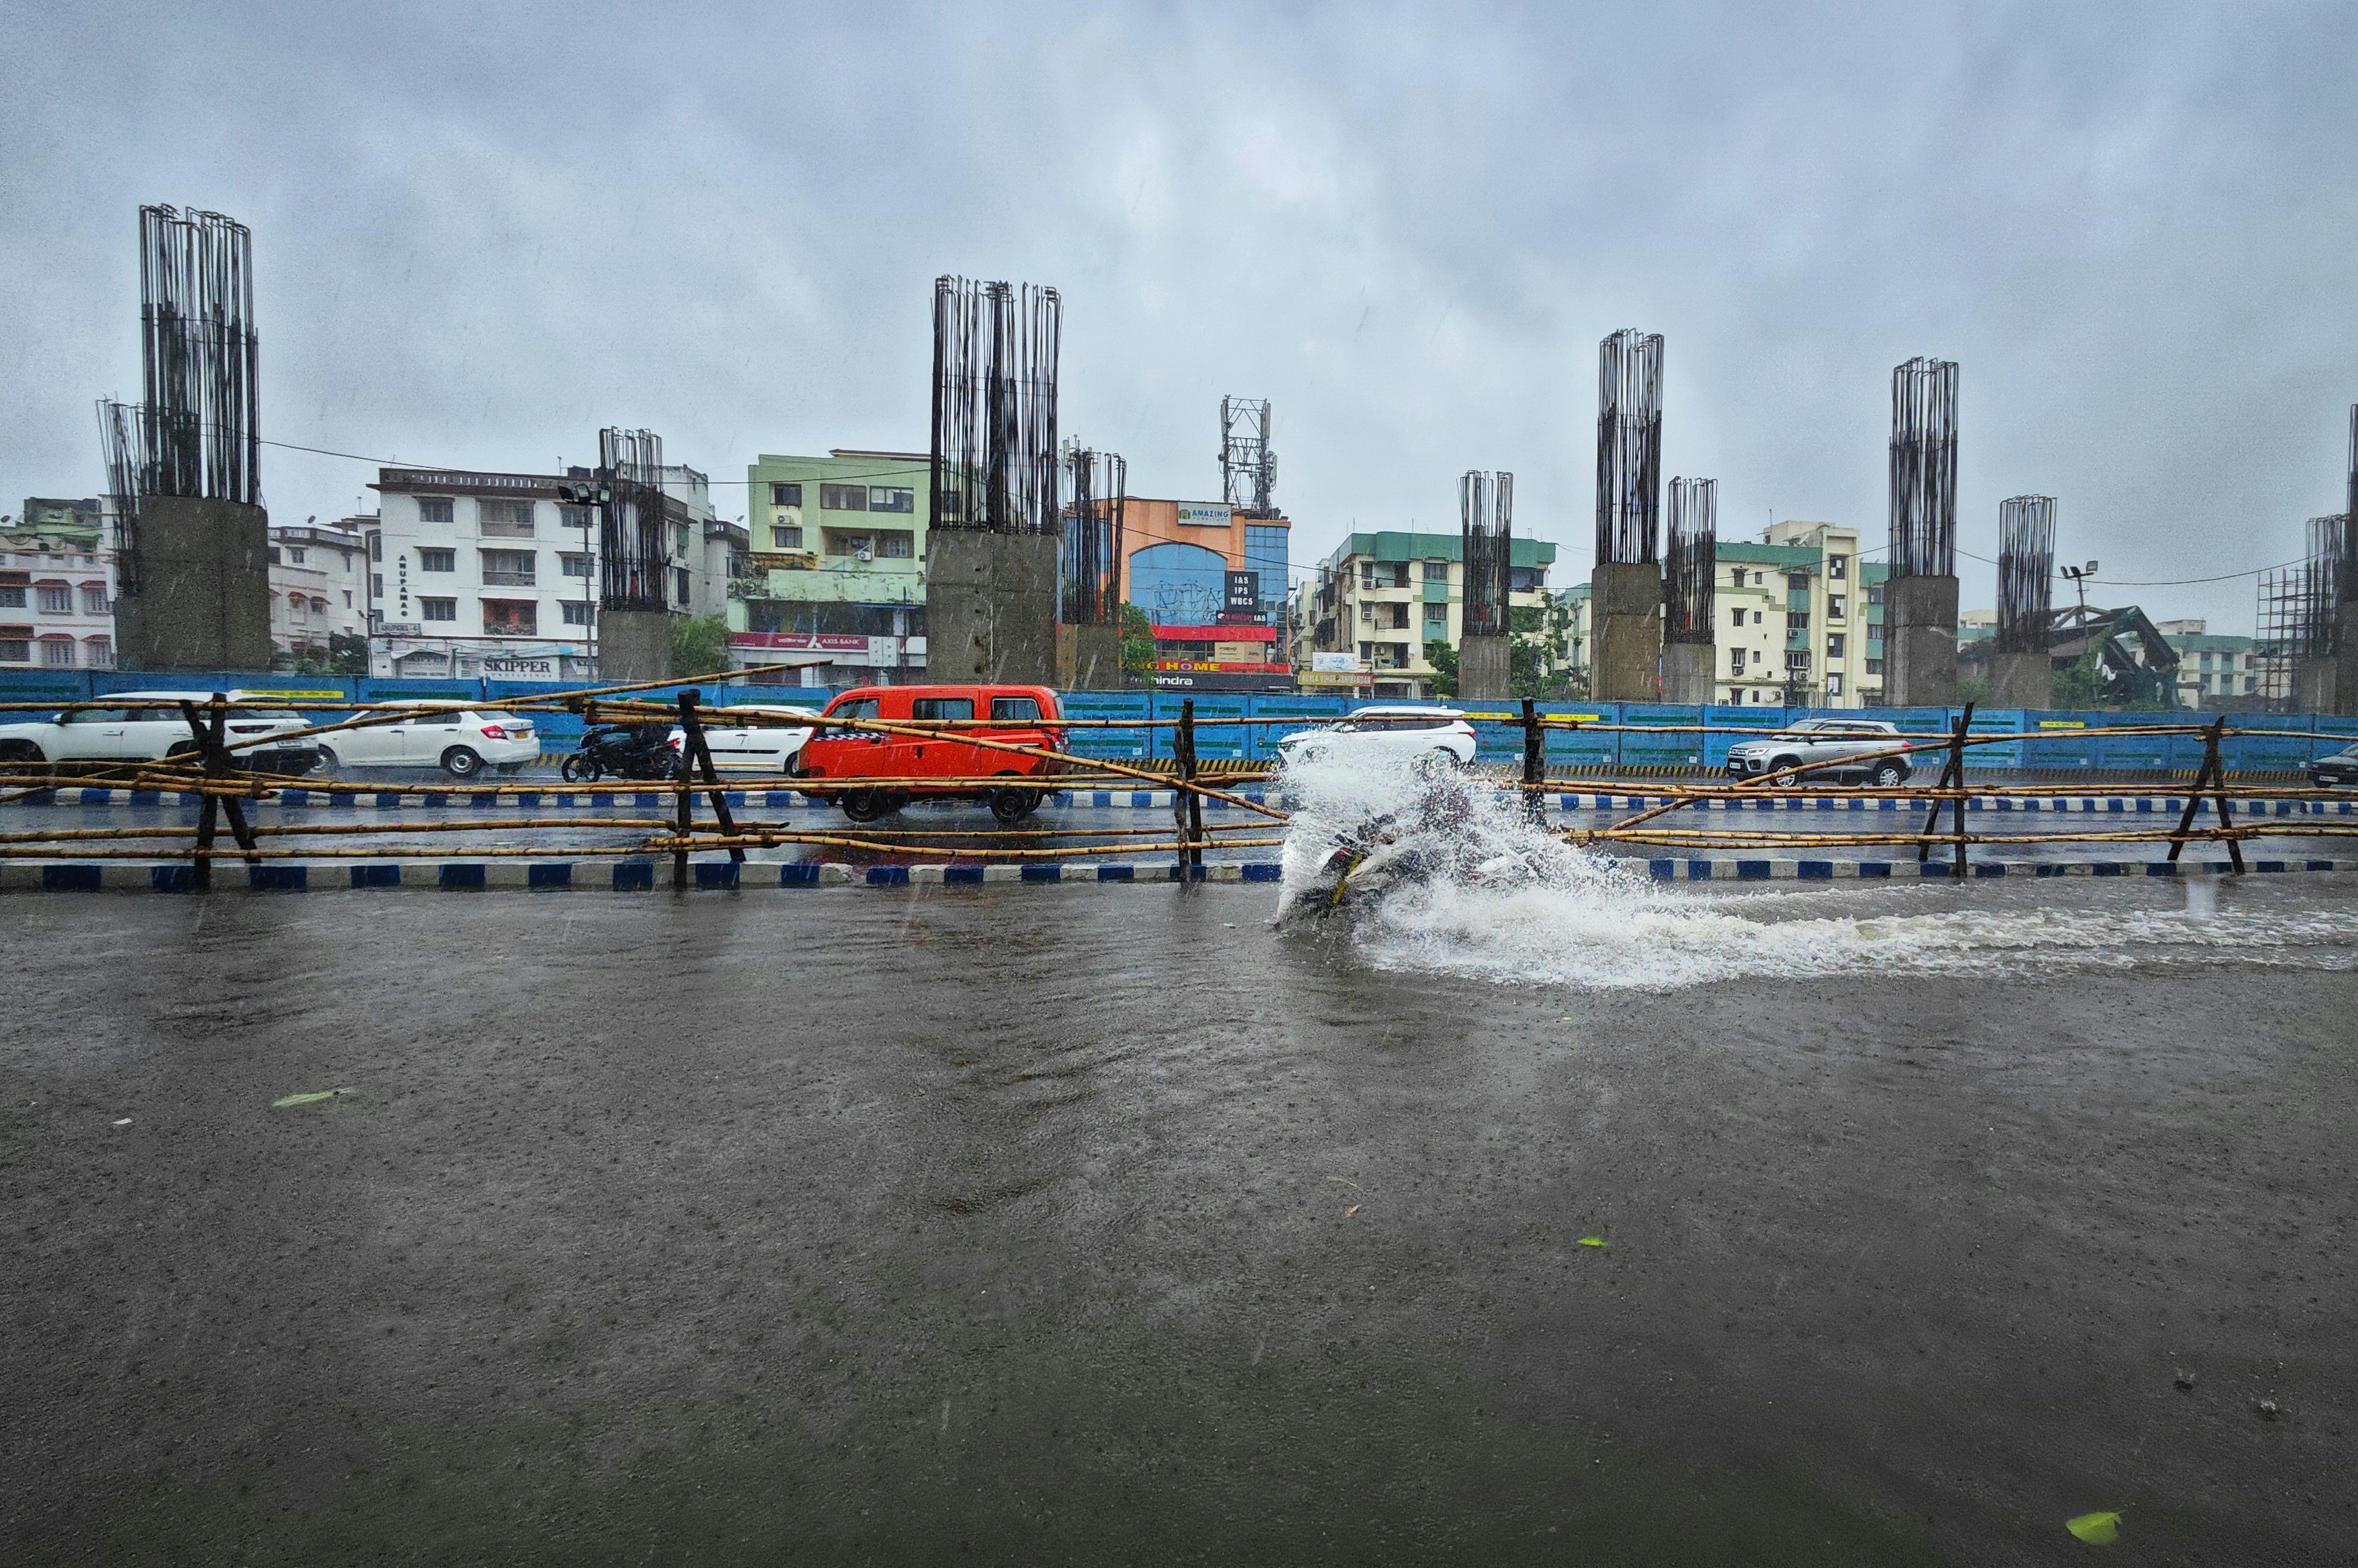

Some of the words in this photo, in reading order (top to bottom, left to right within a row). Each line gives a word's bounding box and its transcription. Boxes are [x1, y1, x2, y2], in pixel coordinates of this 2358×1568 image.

[1234, 576, 1248, 584] IAS
[1234, 586, 1248, 595] IPS
[1230, 597, 1253, 605] WBCS
[484, 659, 551, 672] SKIPPER
[1165, 662, 1221, 672] HOME
